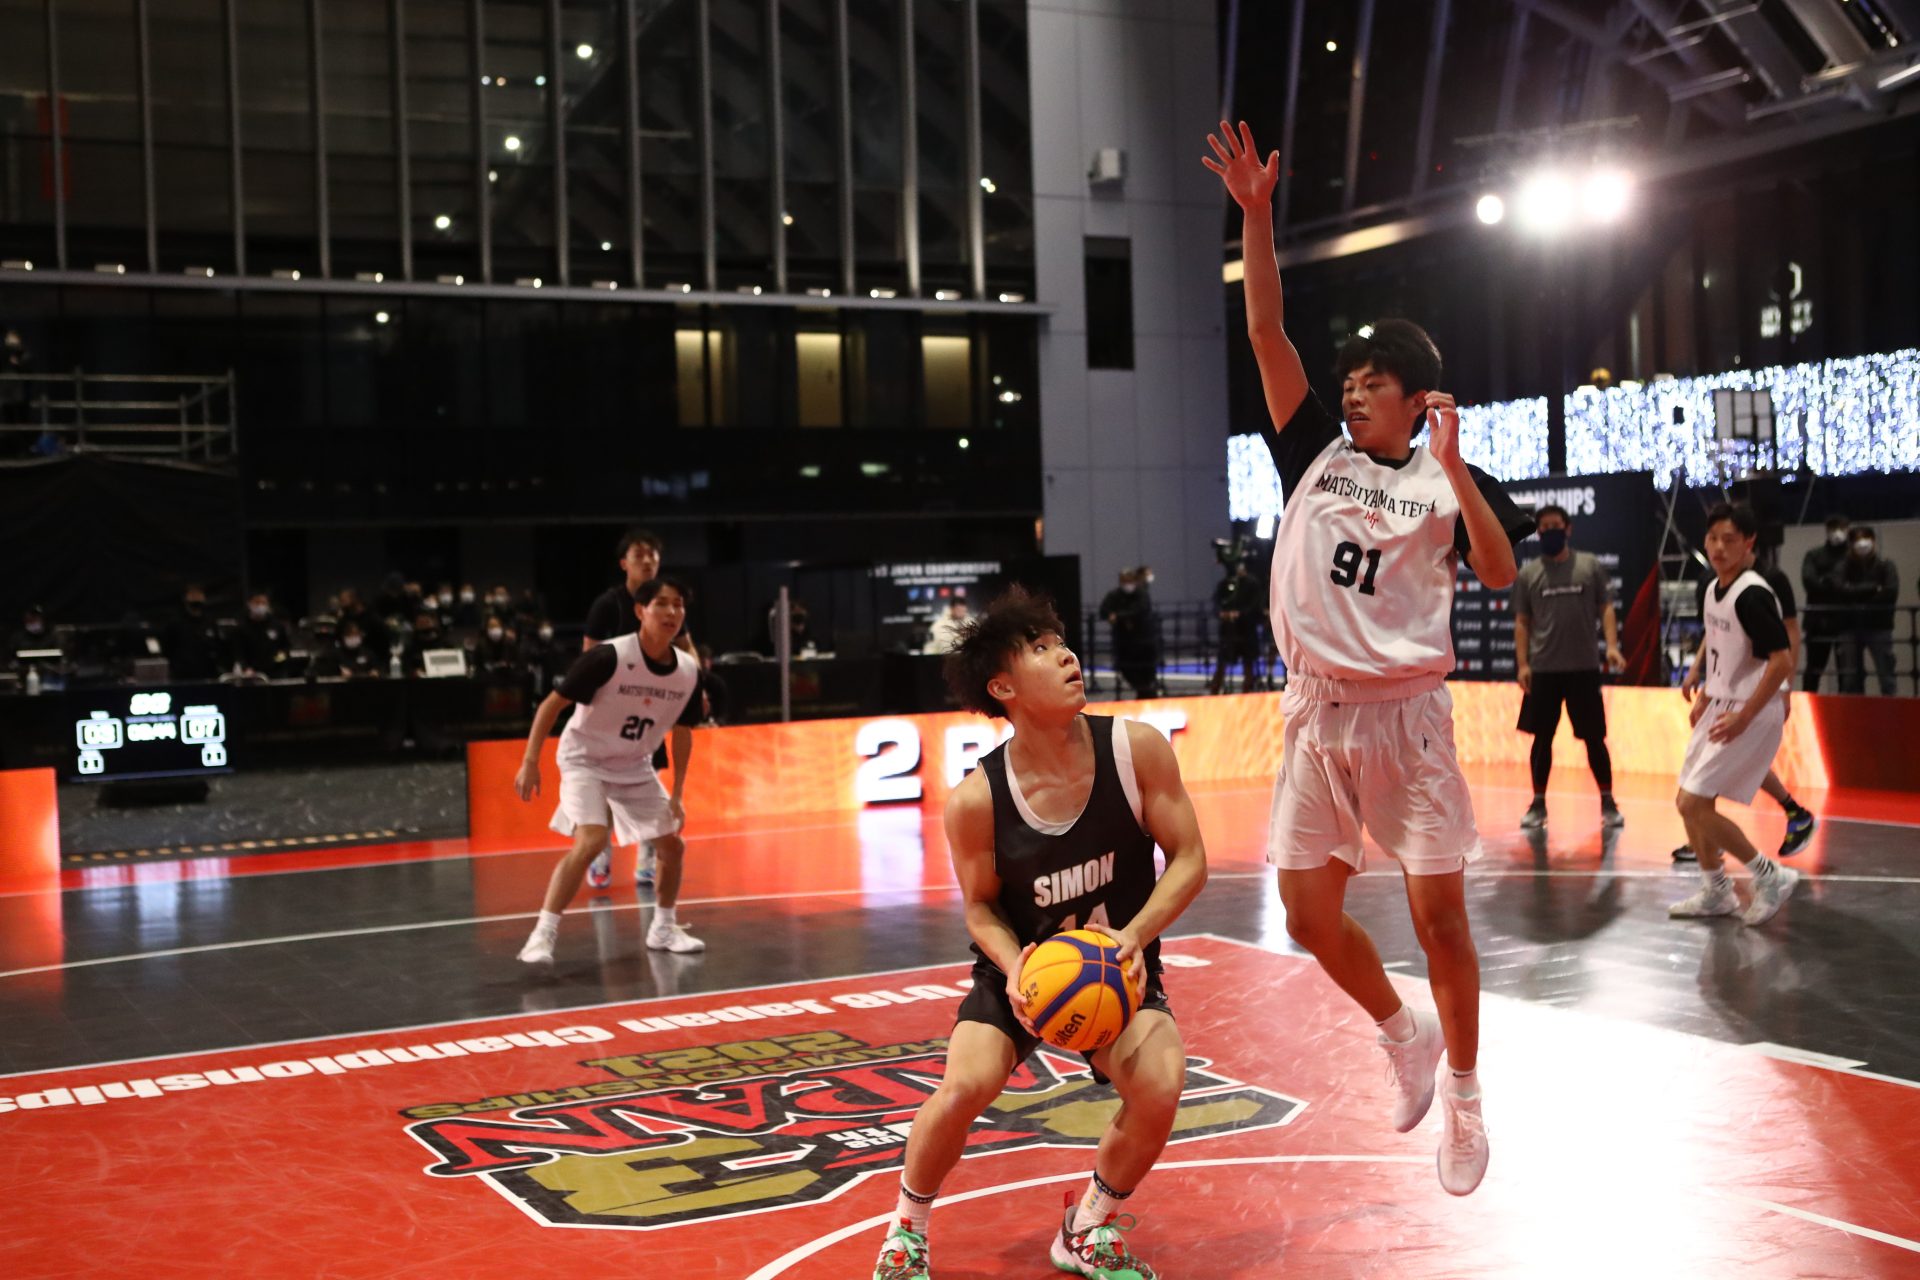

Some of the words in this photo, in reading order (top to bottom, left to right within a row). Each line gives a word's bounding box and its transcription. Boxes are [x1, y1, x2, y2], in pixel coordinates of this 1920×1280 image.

[1315, 473, 1396, 514] MATSUYAMA
[1330, 541, 1382, 596] 91
[856, 719, 922, 804] 2
[1034, 851, 1115, 908] SIMON
[617, 998, 836, 1034] Japan
[402, 1036, 950, 1120] HAMPIONSHIPS
[584, 1029, 868, 1080] 2021
